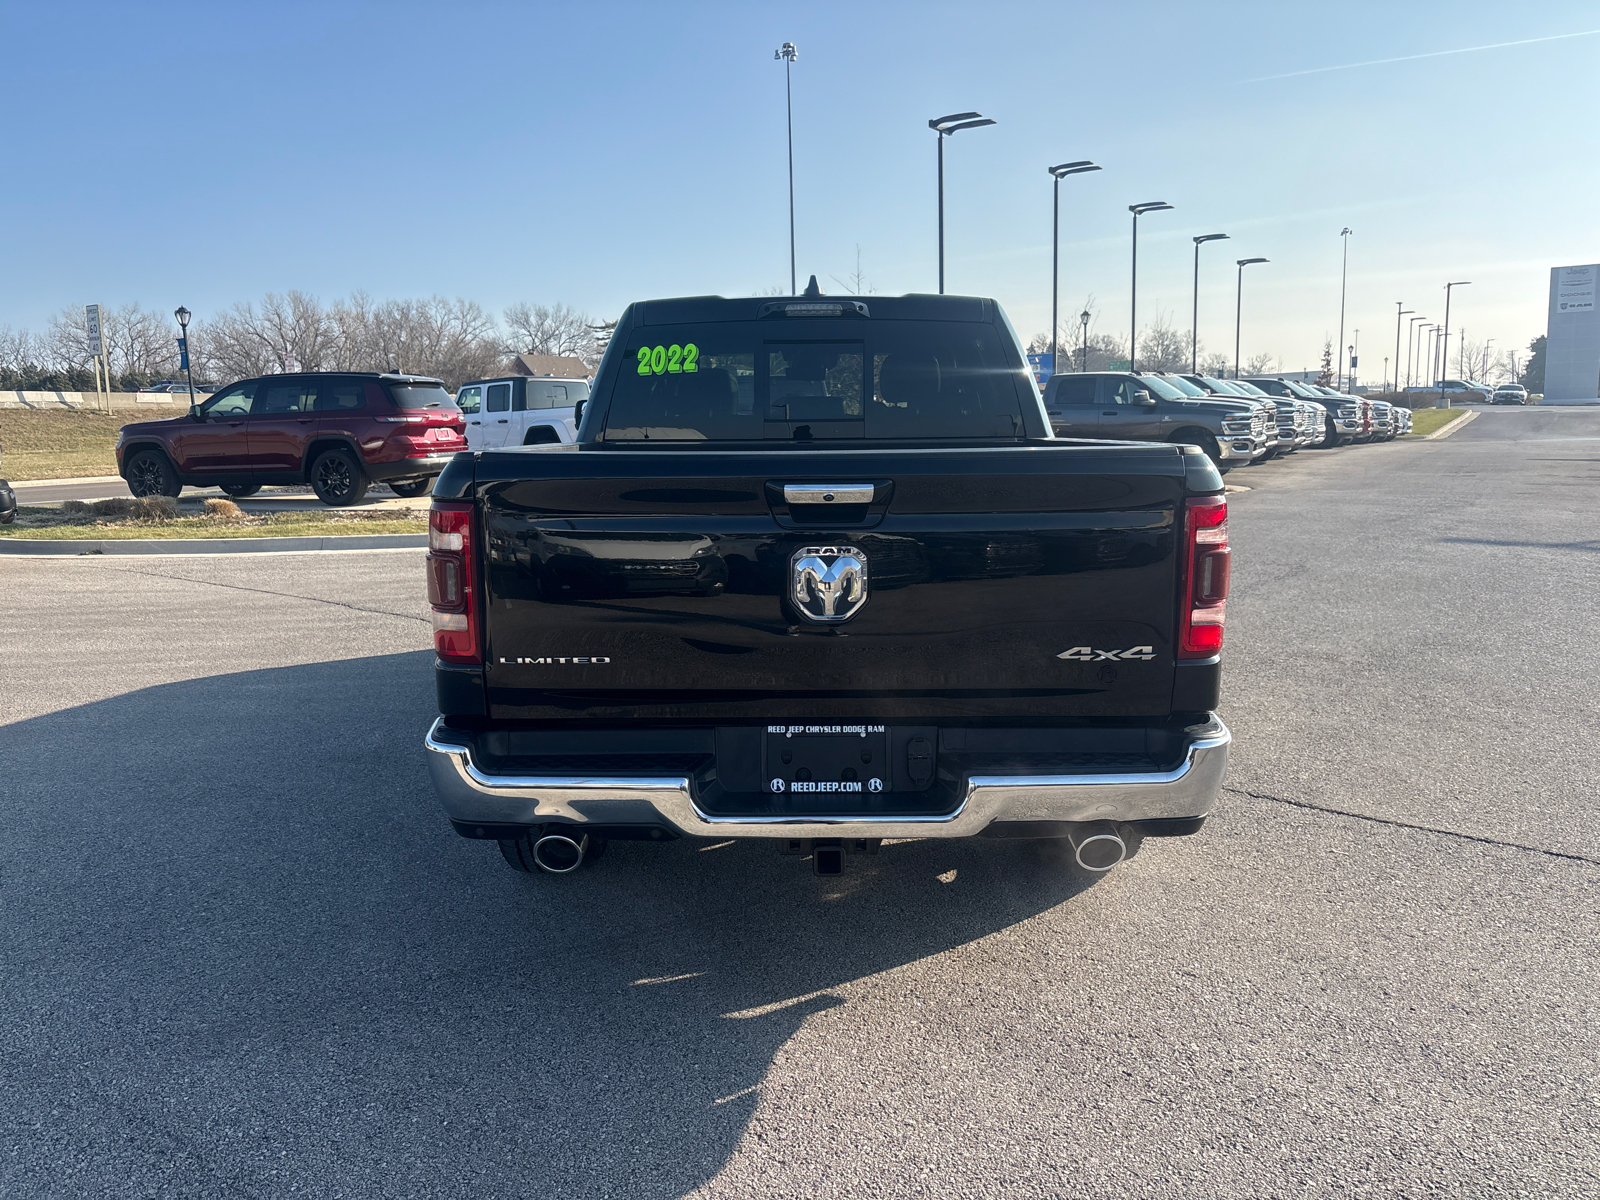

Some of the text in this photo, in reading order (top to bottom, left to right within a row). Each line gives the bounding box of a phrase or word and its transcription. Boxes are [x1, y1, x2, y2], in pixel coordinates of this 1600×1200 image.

[90, 324, 97, 333] 60
[637, 343, 699, 376] 2022
[806, 547, 852, 555] RAM
[1056, 645, 1158, 661] 4x4
[499, 656, 611, 664] LIMITED
[767, 725, 885, 734] REED JEEP CHRYSLER DODGE RAM
[791, 782, 861, 792] REEDJEEP.COM
